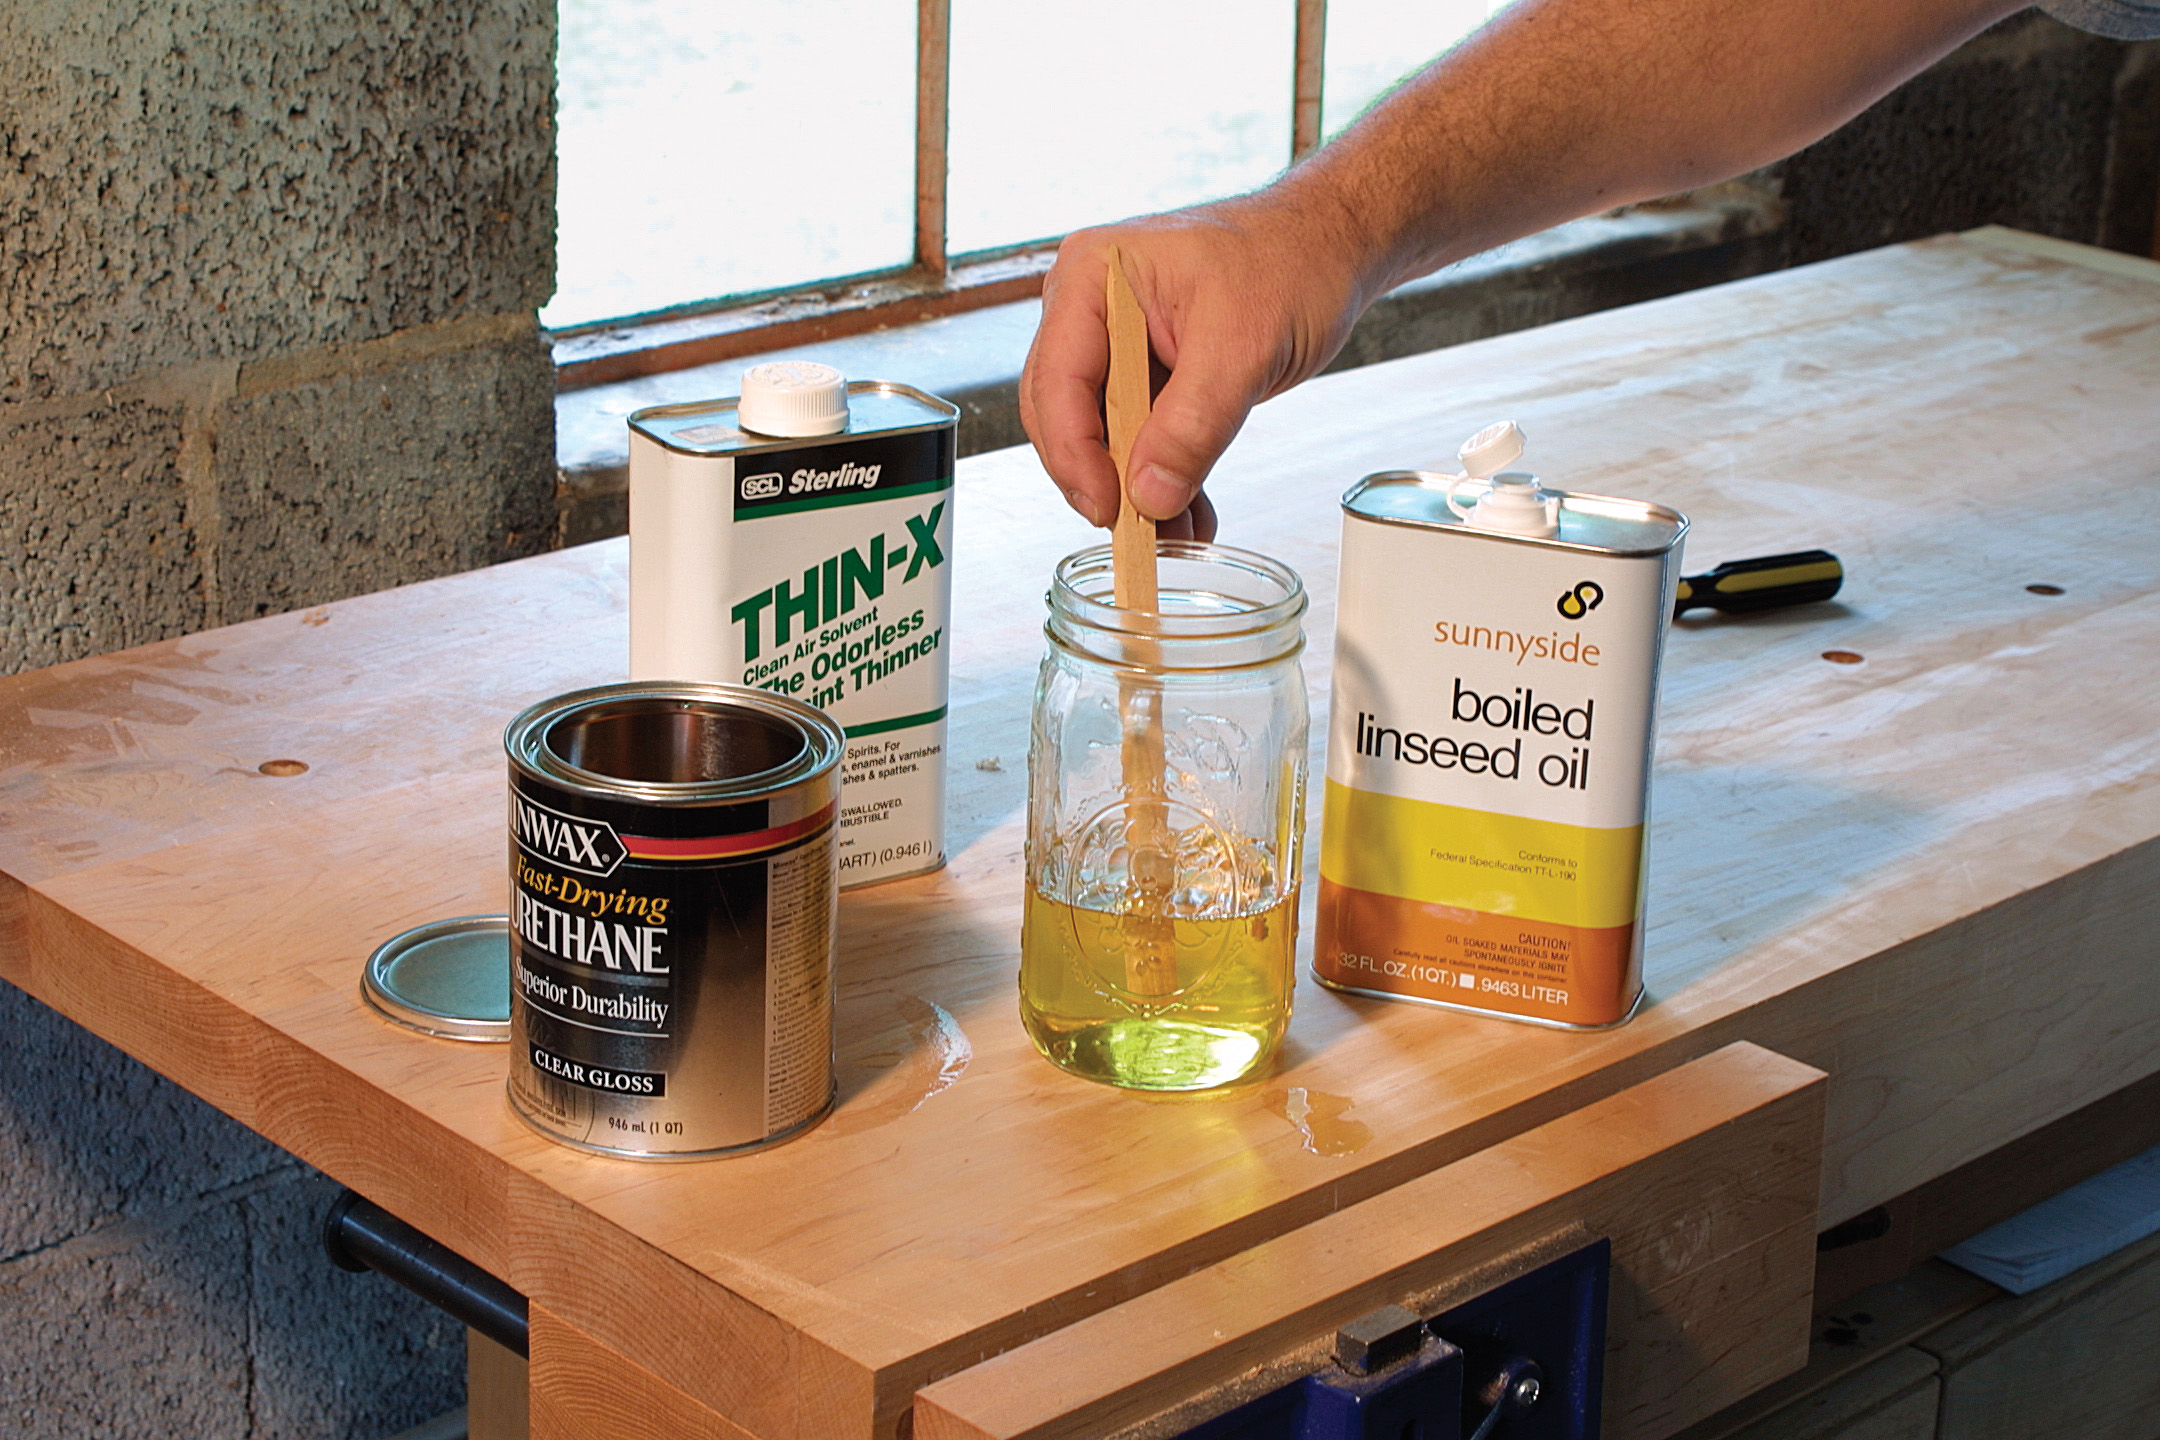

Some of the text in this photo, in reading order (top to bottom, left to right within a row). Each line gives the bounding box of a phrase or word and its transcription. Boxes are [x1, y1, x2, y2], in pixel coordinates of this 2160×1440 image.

[745, 461, 882, 496] SCL Sterling
[731, 499, 946, 664] THIN-X
[743, 606, 878, 686] Clean Air Solvent
[811, 608, 925, 681] Odorless
[1433, 620, 1601, 667] sunnyside
[803, 625, 942, 710] int Thinner
[1452, 677, 1594, 742] boiled
[847, 744, 881, 760] Spirits.
[884, 741, 901, 752] For
[851, 756, 887, 771] enamel
[889, 753, 897, 763] &
[868, 770, 876, 780] &
[878, 762, 920, 780] spatters.
[1356, 711, 1590, 791] linseed oil
[510, 788, 604, 869] INWAX
[1430, 848, 1467, 863] Federal
[1469, 855, 1532, 874] Specification
[1518, 850, 1578, 868] Conforms to
[516, 853, 670, 925] Fast-Drying
[1446, 934, 1570, 962] OIL SOAKED MATERIALS MAY
[1464, 948, 1536, 968] SPONTANEOUSLY
[515, 955, 669, 1030] Superior Durability
[1339, 951, 1357, 969] 32
[1522, 984, 1569, 1006] LITER
[535, 1049, 654, 1094] CLEAR GLOSS
[608, 1116, 628, 1131] 946
[664, 1121, 684, 1136] QT)
